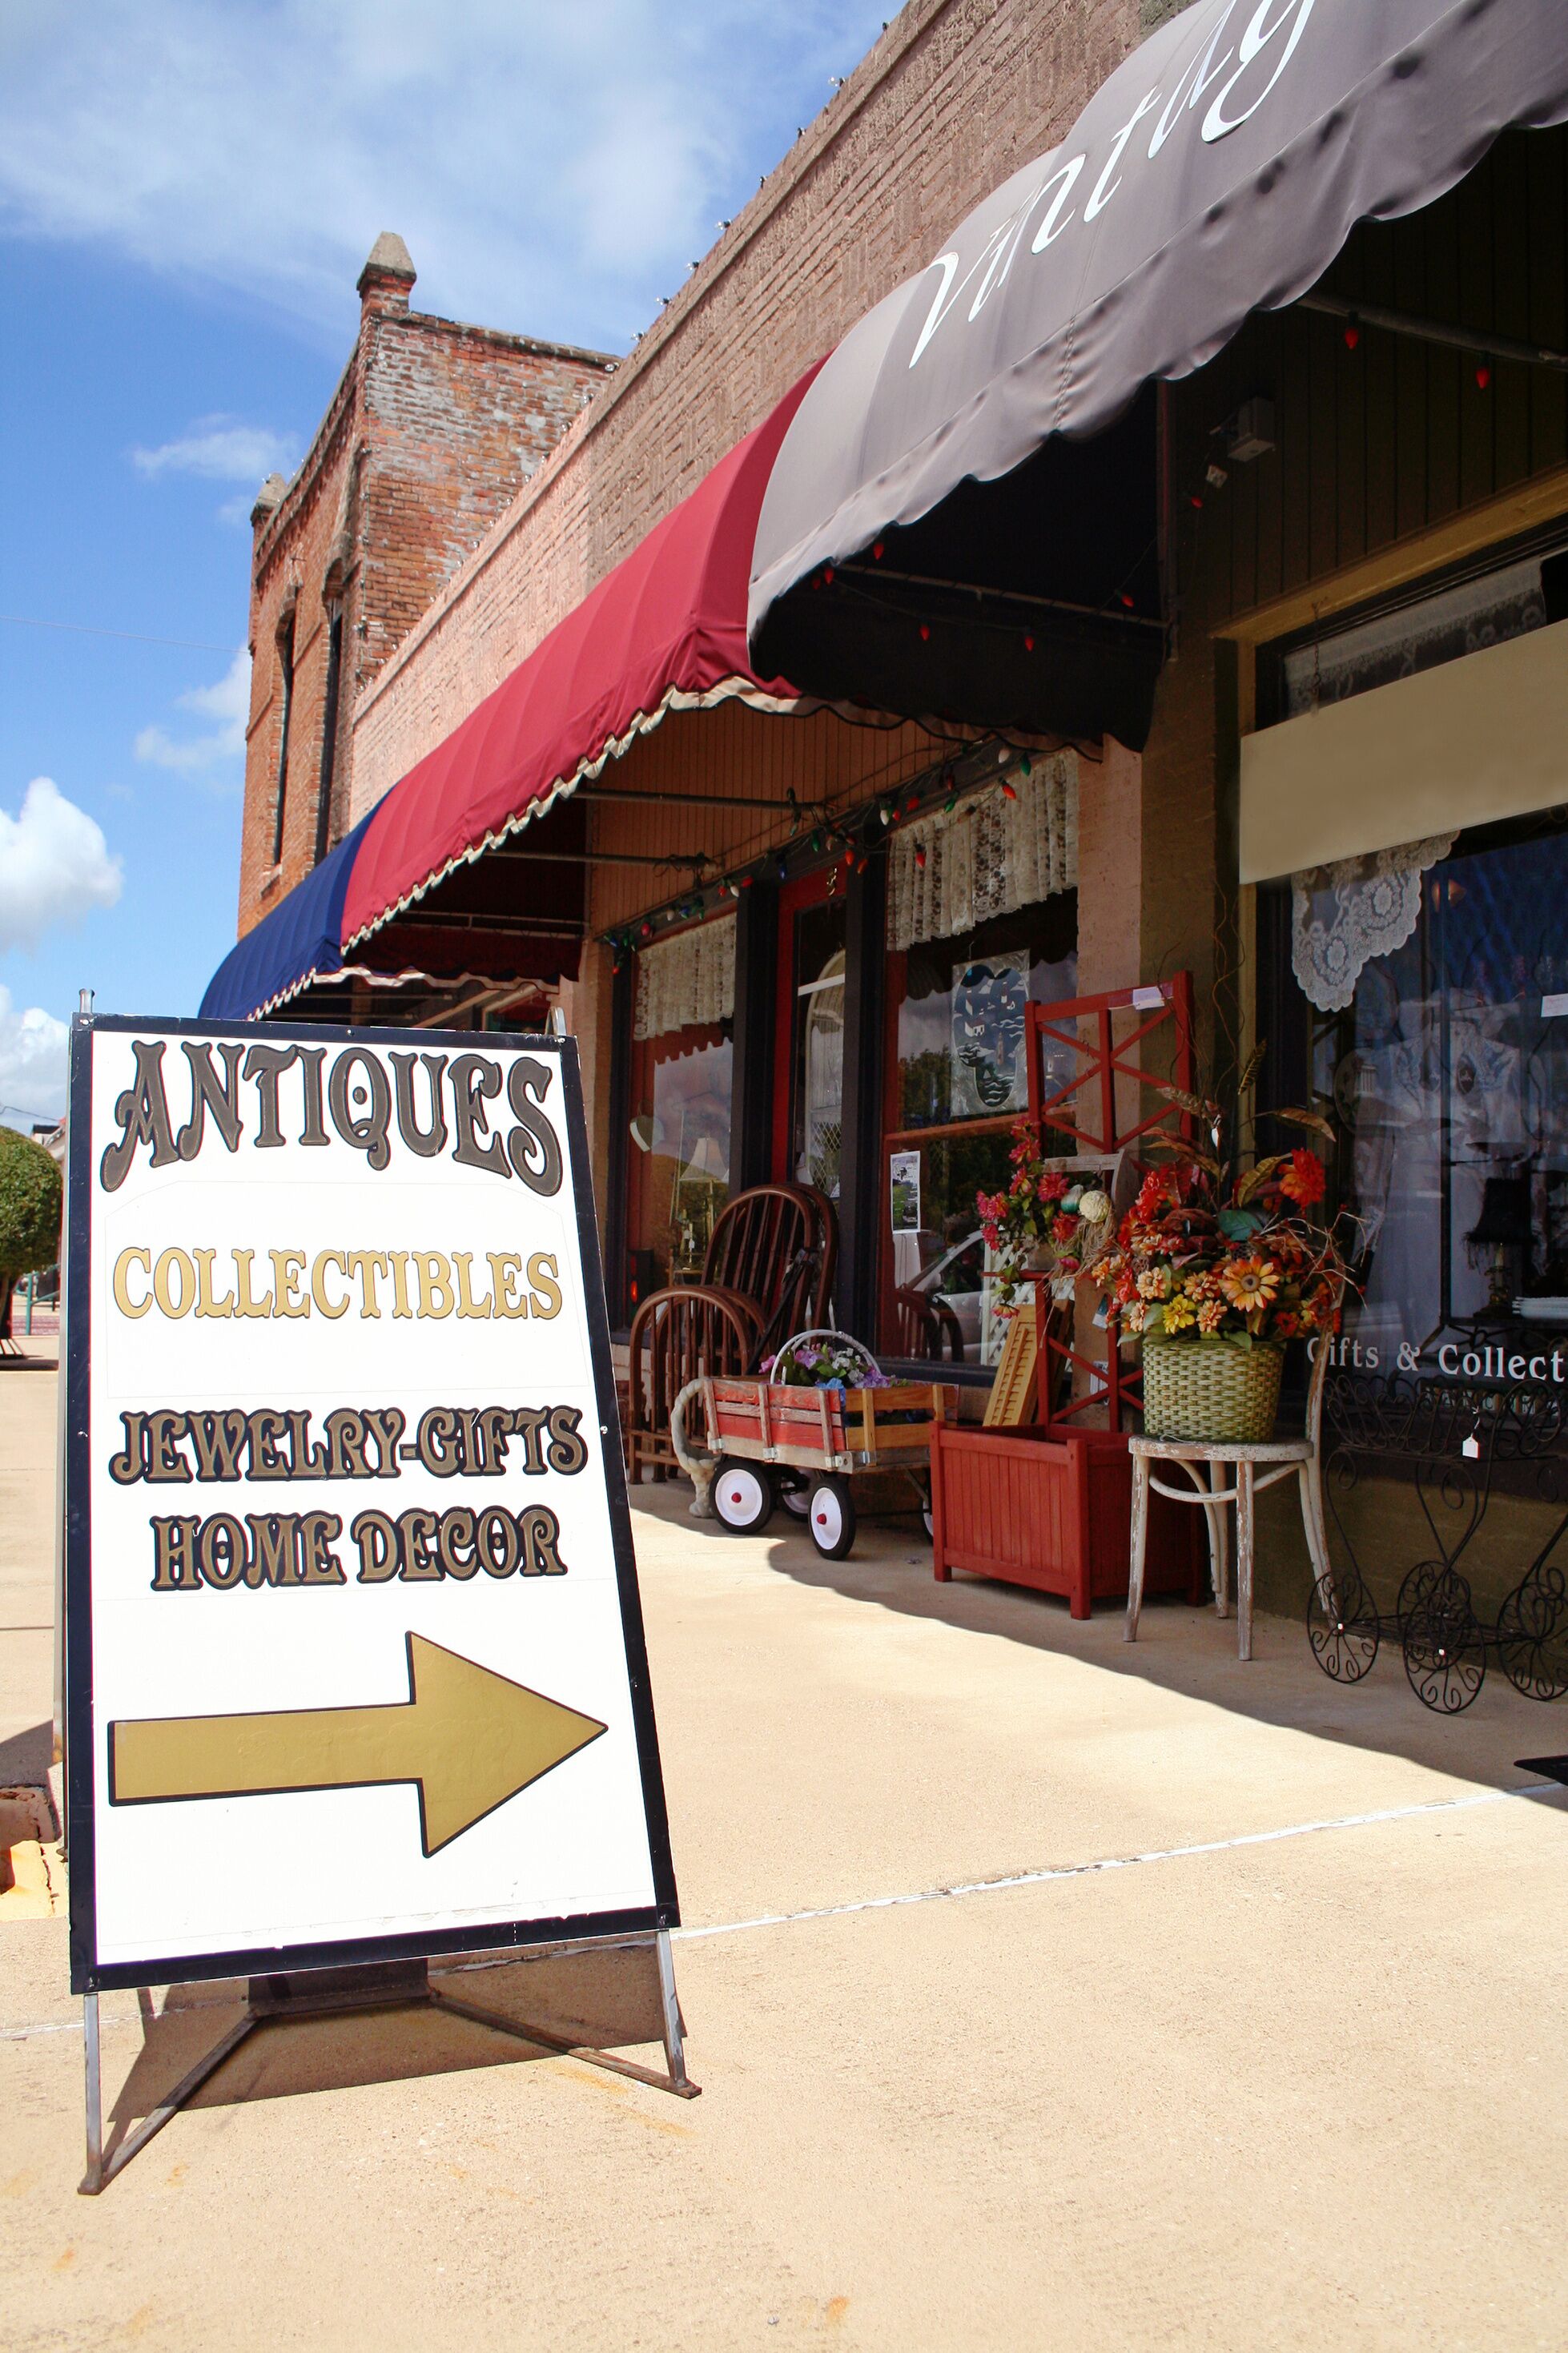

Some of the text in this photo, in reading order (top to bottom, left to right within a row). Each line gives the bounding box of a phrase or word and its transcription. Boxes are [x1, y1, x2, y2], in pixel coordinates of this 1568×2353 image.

[100, 1040, 564, 1197] ANTIQUES
[113, 1247, 563, 1320] COLLECTIBLES
[1396, 1341, 1421, 1371] &
[1438, 1343, 1566, 1382] Collect
[109, 1406, 589, 1486] JEWELRY-GIFTS
[150, 1505, 568, 1591] HOME DECOR
